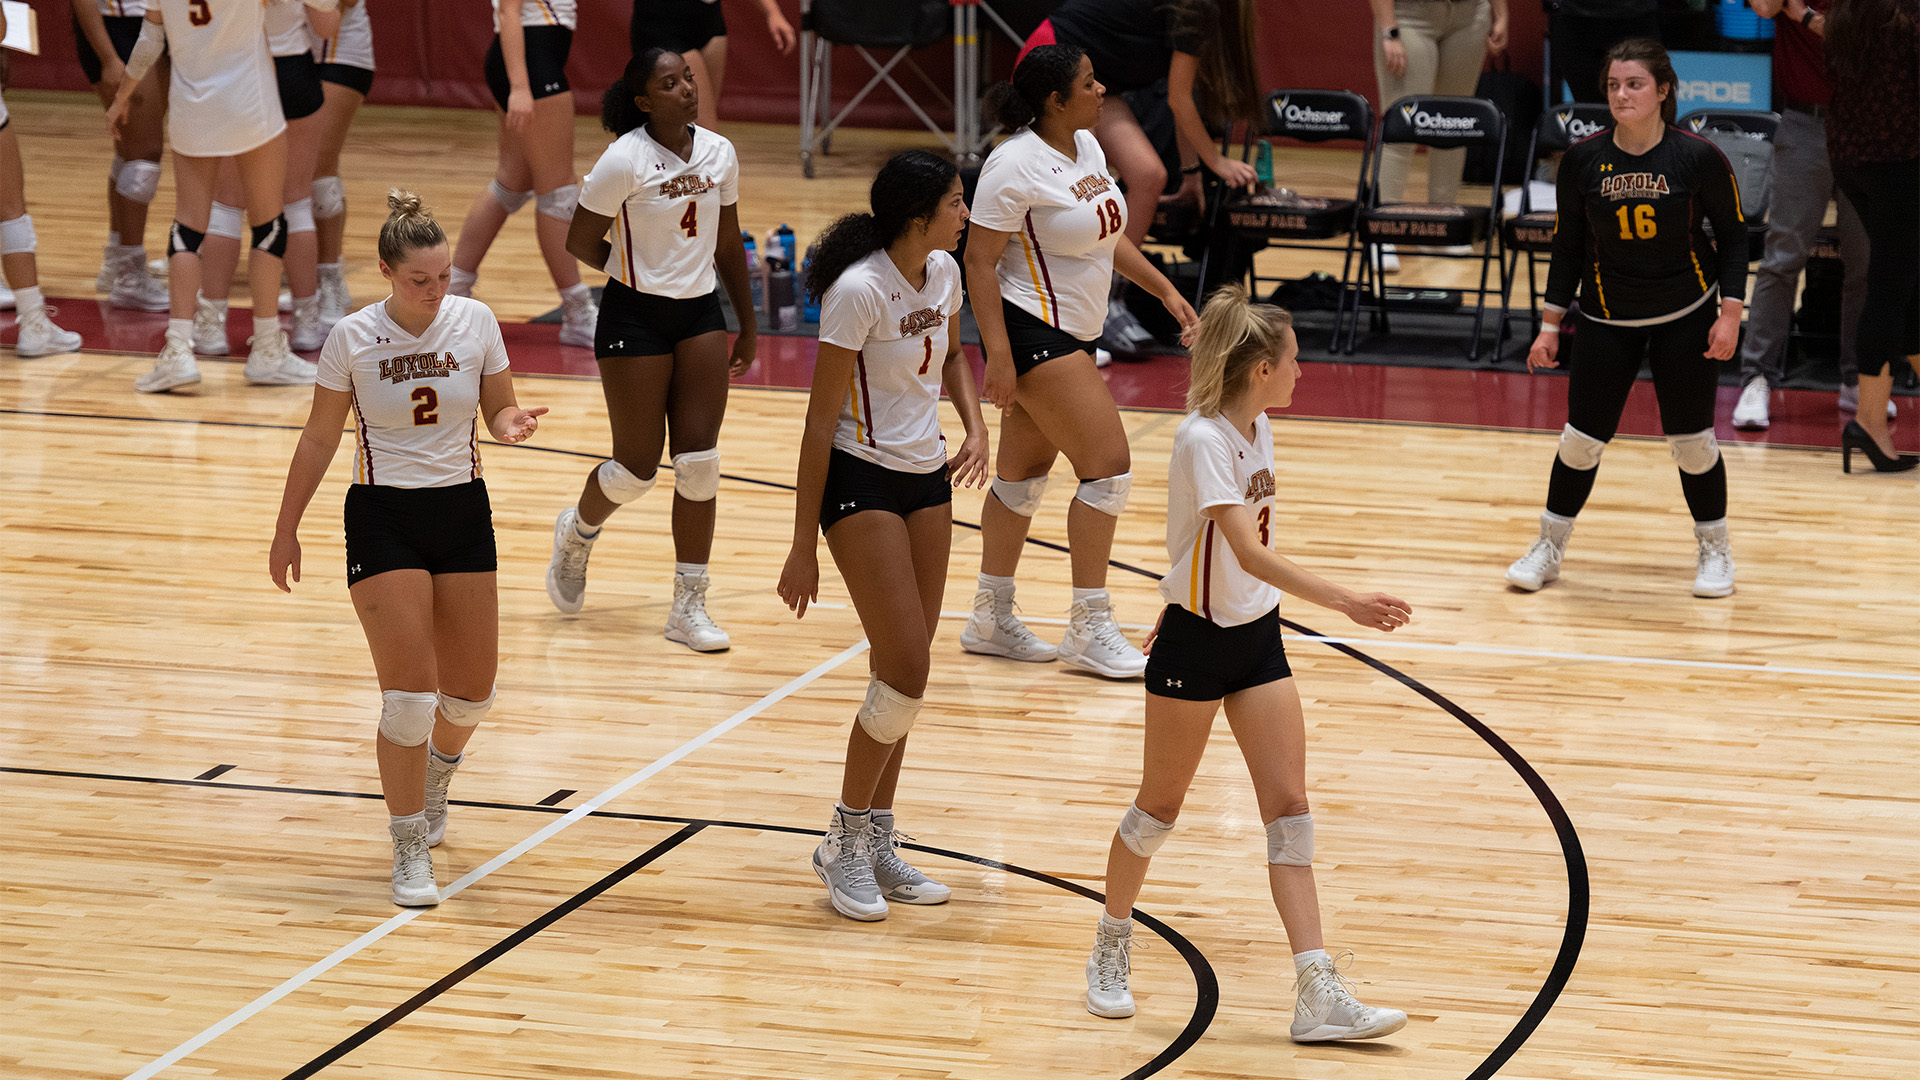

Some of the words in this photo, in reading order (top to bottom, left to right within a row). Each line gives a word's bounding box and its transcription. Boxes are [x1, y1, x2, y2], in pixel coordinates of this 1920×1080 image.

[1678, 80, 1751, 104] RADE
[1285, 104, 1344, 124] Ochsner
[1414, 111, 1477, 130] Ochsner
[659, 174, 714, 196] LOYOLA
[1069, 171, 1112, 202] LOYOLA
[1601, 172, 1670, 197] LOYOLA
[680, 200, 697, 238] 4
[1096, 197, 1122, 241] 18
[1230, 213, 1268, 227] WOLF
[1270, 215, 1307, 229] PACK
[1368, 220, 1408, 235] WOLF
[1411, 222, 1448, 237] PACK
[1616, 204, 1657, 239] 16
[379, 352, 460, 381] LOYOLA
[918, 334, 932, 376] 1
[392, 373, 411, 384] NEW
[410, 386, 438, 426] 2
[1257, 505, 1270, 548] 3
